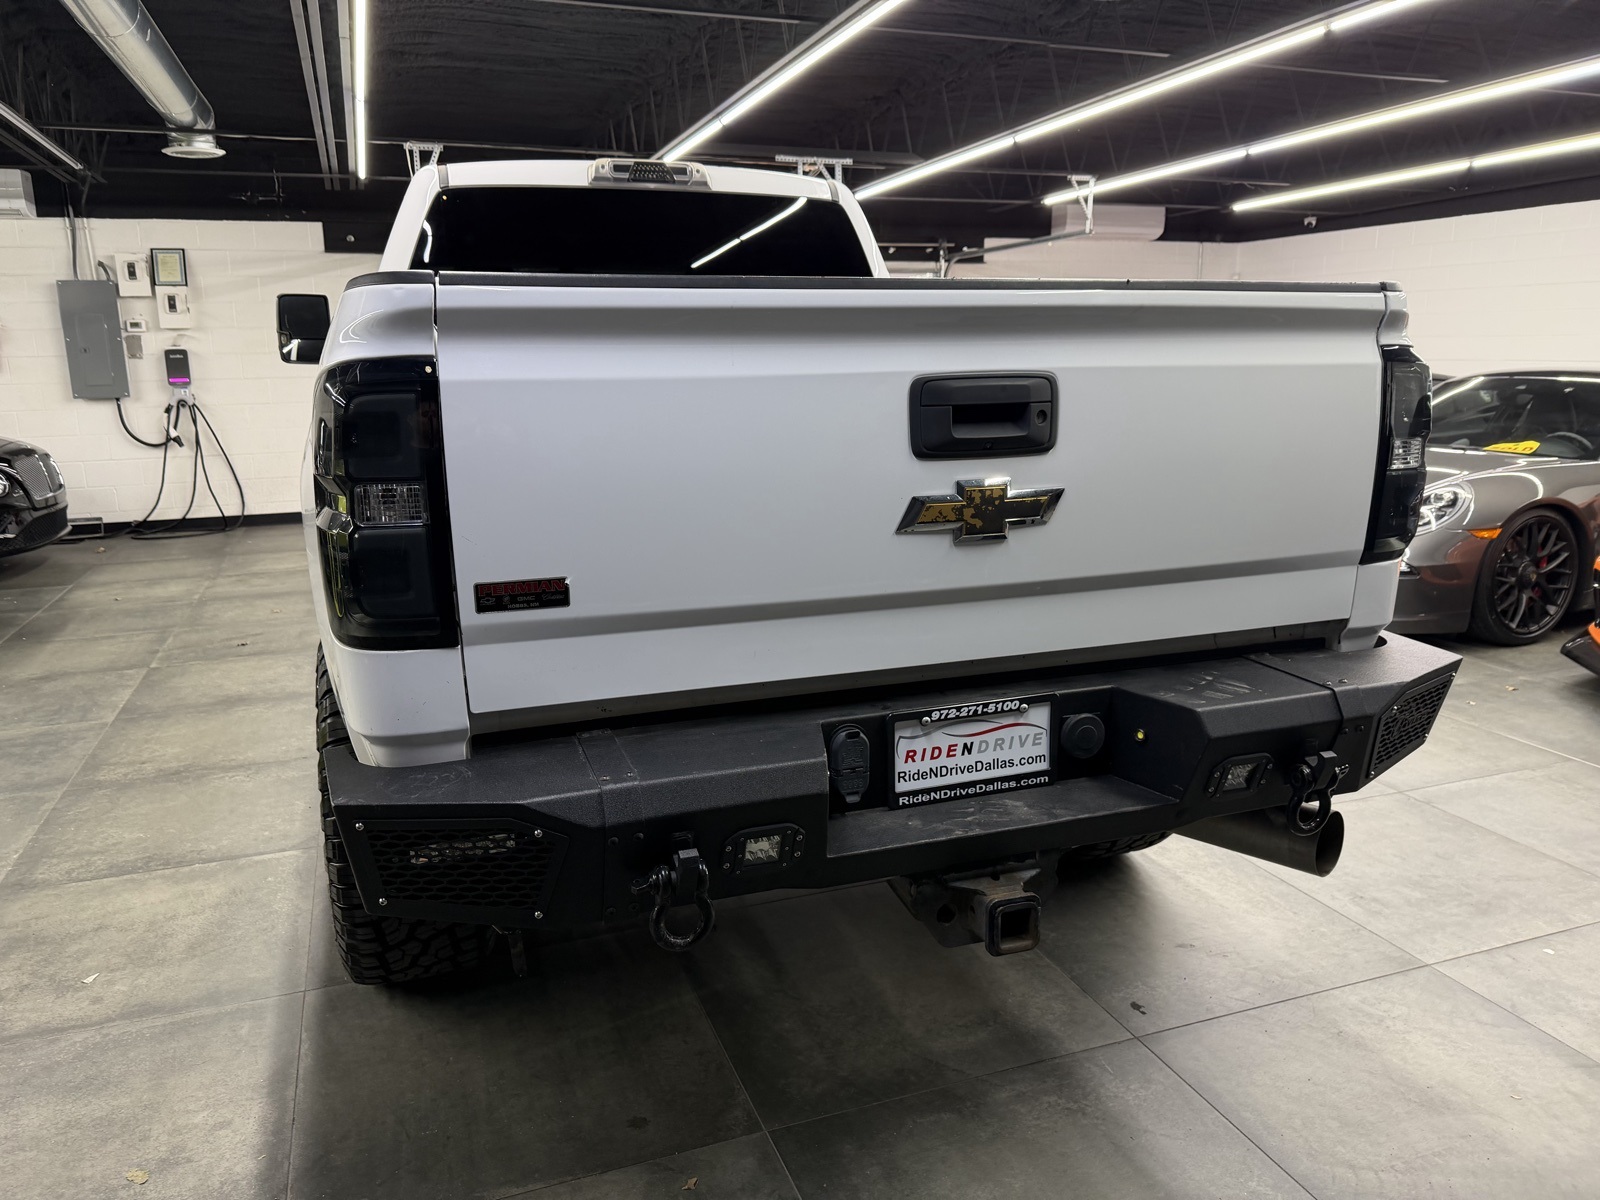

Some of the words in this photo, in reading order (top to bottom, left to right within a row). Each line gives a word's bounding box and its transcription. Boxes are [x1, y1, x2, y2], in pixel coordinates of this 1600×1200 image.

[478, 580, 565, 596] PERMIAN
[931, 700, 1020, 721] 972-271-5100
[904, 732, 1044, 764] RIDENDRIVE
[897, 754, 1046, 784] RideNDriveDallas.com
[899, 775, 1049, 806] RideNDriveDallas.com
